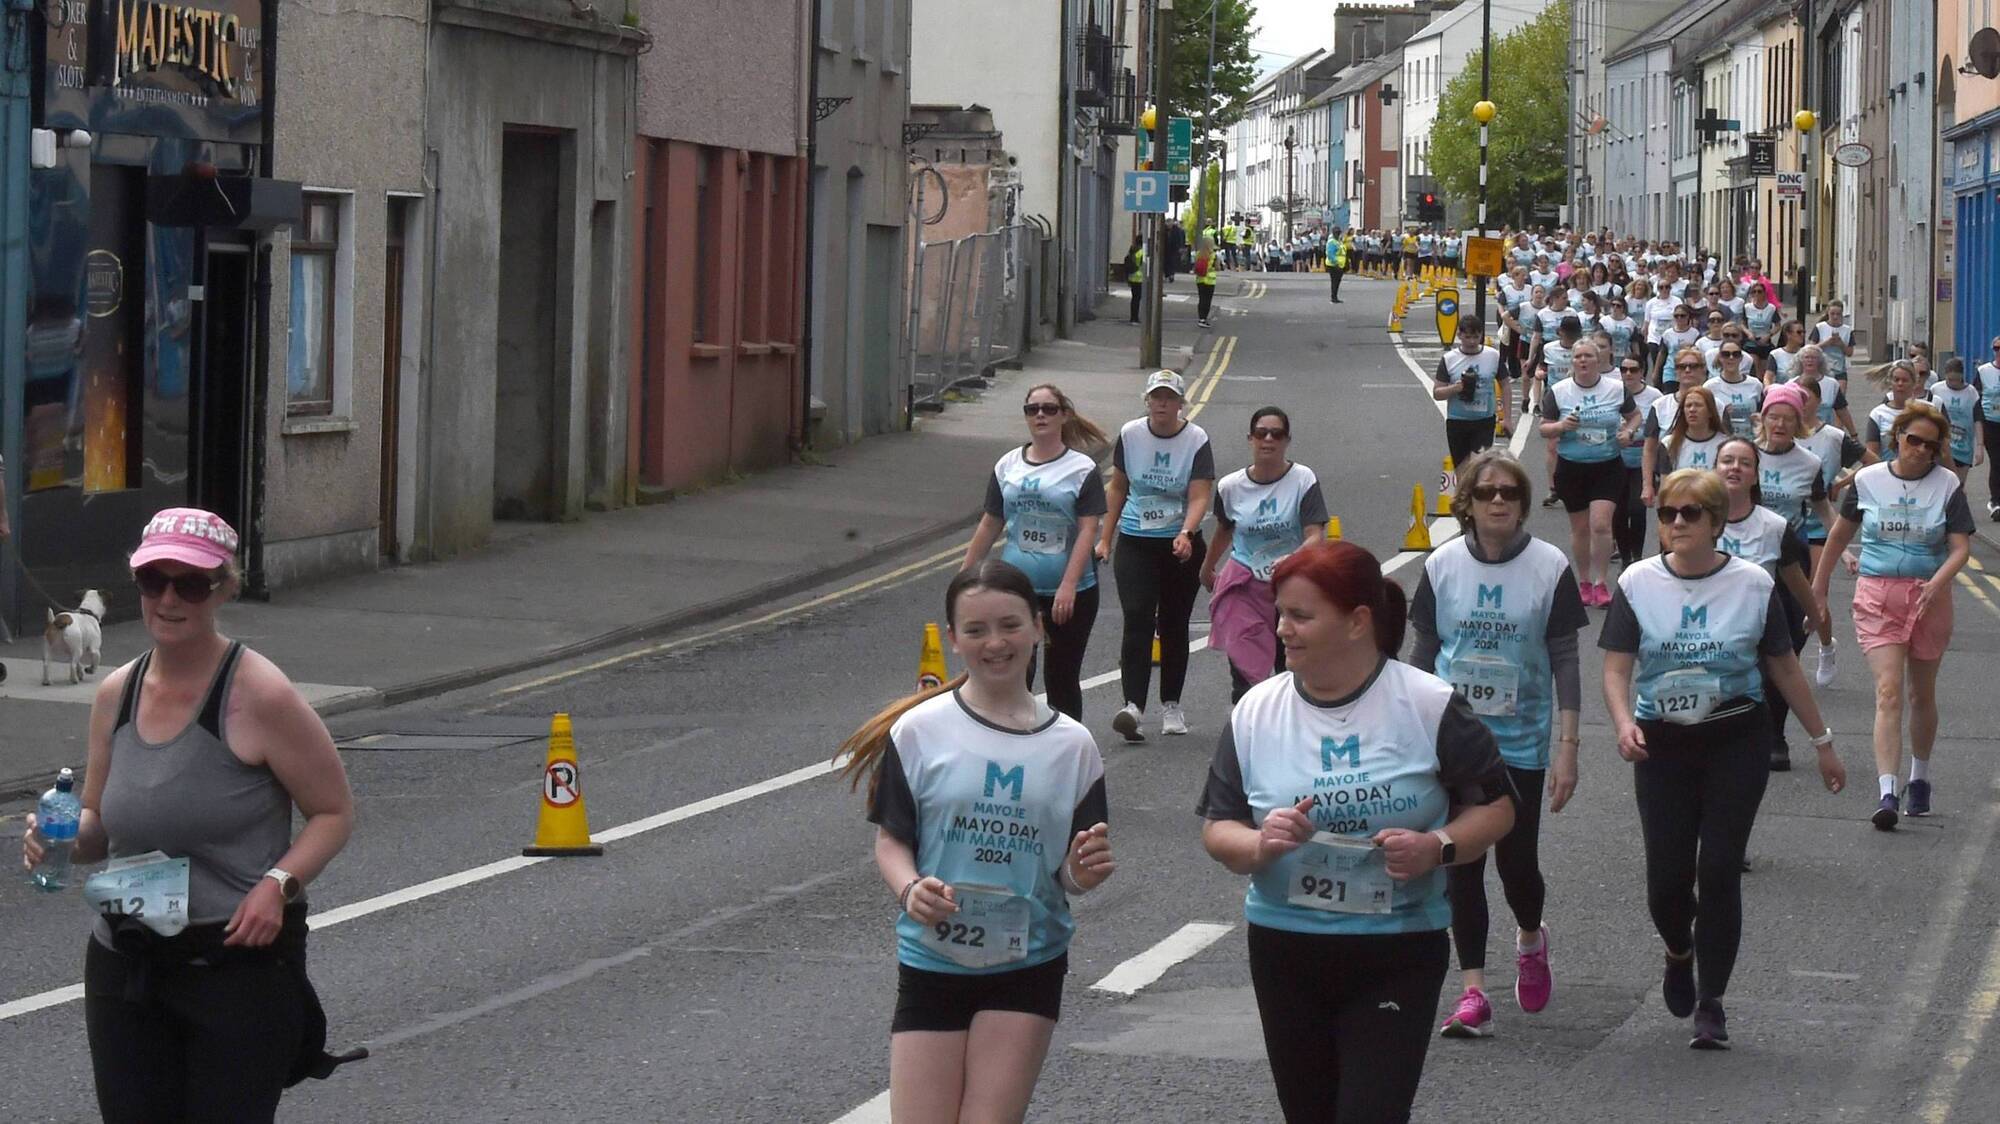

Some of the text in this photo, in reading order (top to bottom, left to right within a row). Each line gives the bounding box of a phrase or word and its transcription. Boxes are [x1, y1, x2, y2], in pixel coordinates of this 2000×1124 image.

[67, 28, 78, 61] &
[113, 0, 240, 98] MAJESTIC
[57, 65, 85, 89] SLOTS
[1135, 176, 1157, 206] P
[1154, 451, 1170, 467] M
[1764, 470, 1780, 485] M
[1143, 509, 1164, 520] 903
[1259, 497, 1277, 515] M
[1880, 520, 1911, 532] 1304
[1023, 530, 1047, 543] 985
[1477, 584, 1503, 609] M
[1681, 604, 1708, 629] M
[1457, 620, 1518, 633] MAYO DAY
[1473, 639, 1500, 650] 2024
[1661, 641, 1725, 652] MAYO DAY
[1674, 651, 1738, 660] MARATHON
[1657, 694, 1699, 713] 1227
[1321, 733, 1361, 772] M
[983, 759, 1025, 801] M
[1313, 772, 1371, 788] MAYO.IE
[1355, 785, 1392, 802] DAY
[973, 802, 1026, 819] MAYO.IE
[1316, 794, 1418, 821] MARATHON
[953, 815, 1040, 840] MAYO DAY
[1327, 818, 1369, 834] 2024
[974, 847, 1012, 864] 2024
[1301, 875, 1347, 902] 921
[934, 921, 985, 948] 922
